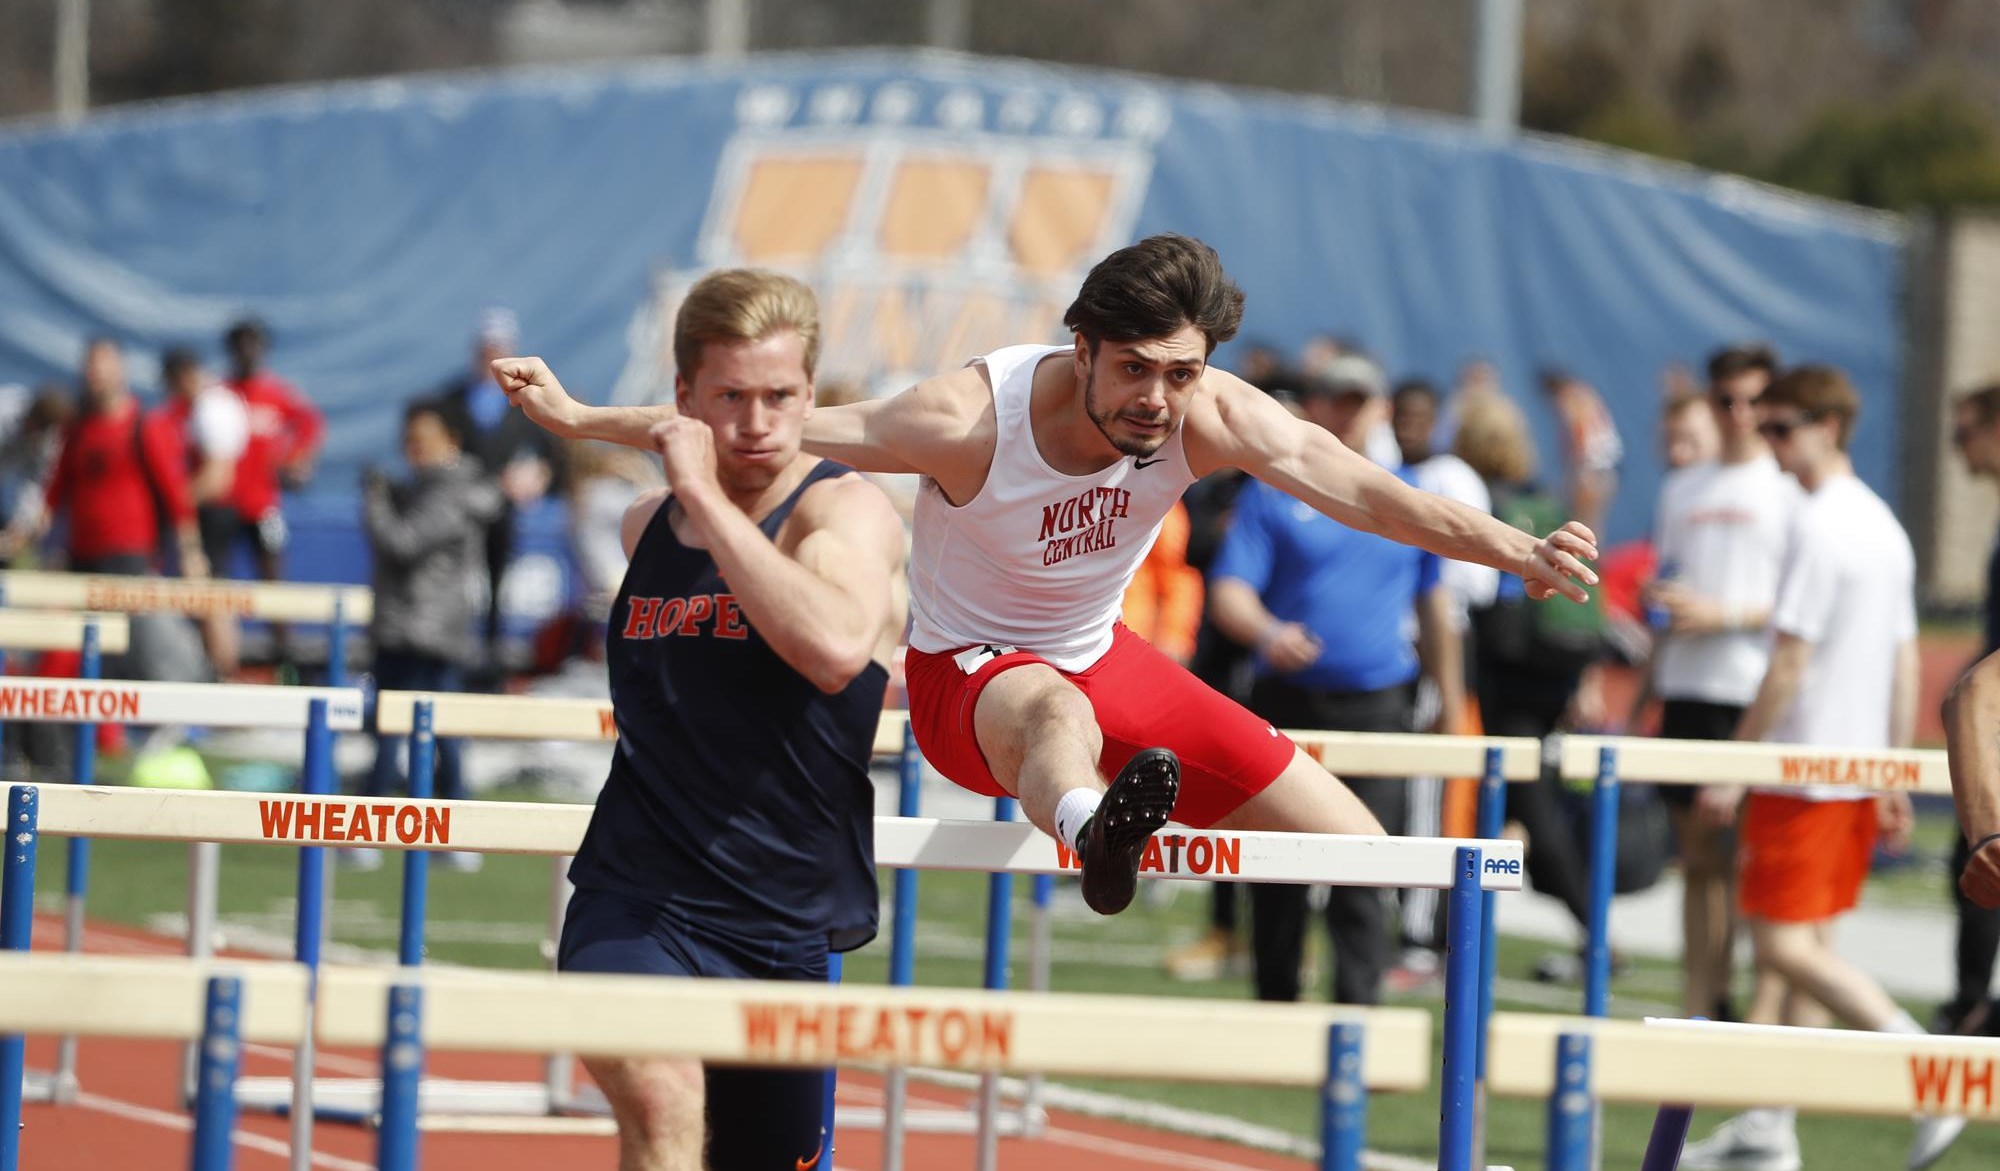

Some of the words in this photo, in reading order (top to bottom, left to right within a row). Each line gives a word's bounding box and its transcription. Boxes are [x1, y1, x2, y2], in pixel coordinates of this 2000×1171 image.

[1038, 486, 1131, 542] NORTH
[1043, 519, 1116, 567] CENTRAL
[622, 593, 748, 640] HOPE
[0, 686, 139, 717] WHEATON
[1780, 757, 1921, 787] WHEATON
[259, 801, 450, 844] WHEATON
[1055, 834, 1240, 875] WATON
[741, 1002, 1013, 1062] WHEATON
